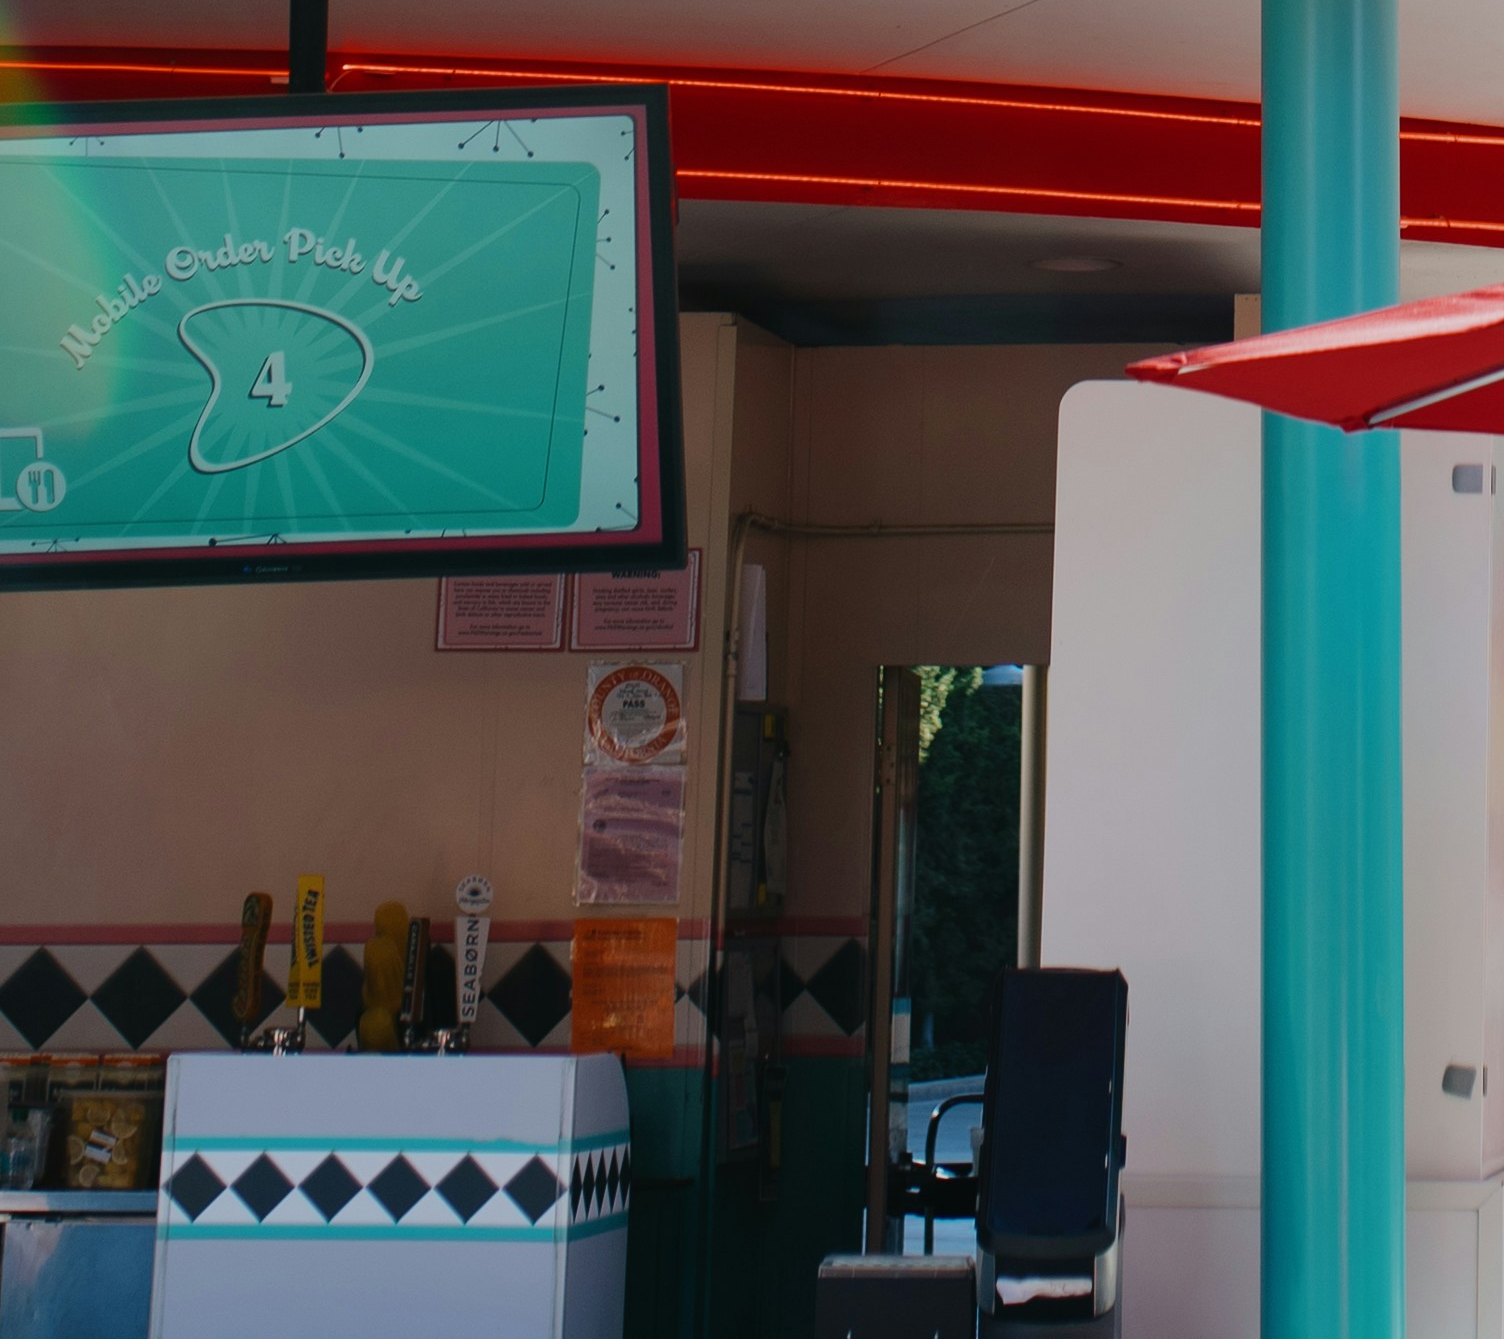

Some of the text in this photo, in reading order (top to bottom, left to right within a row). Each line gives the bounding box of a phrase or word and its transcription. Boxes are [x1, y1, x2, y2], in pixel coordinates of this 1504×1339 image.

[59, 227, 423, 371] Mobile Order Pick Up
[248, 351, 293, 408] 4
[462, 917, 480, 1017] SEABØRN
